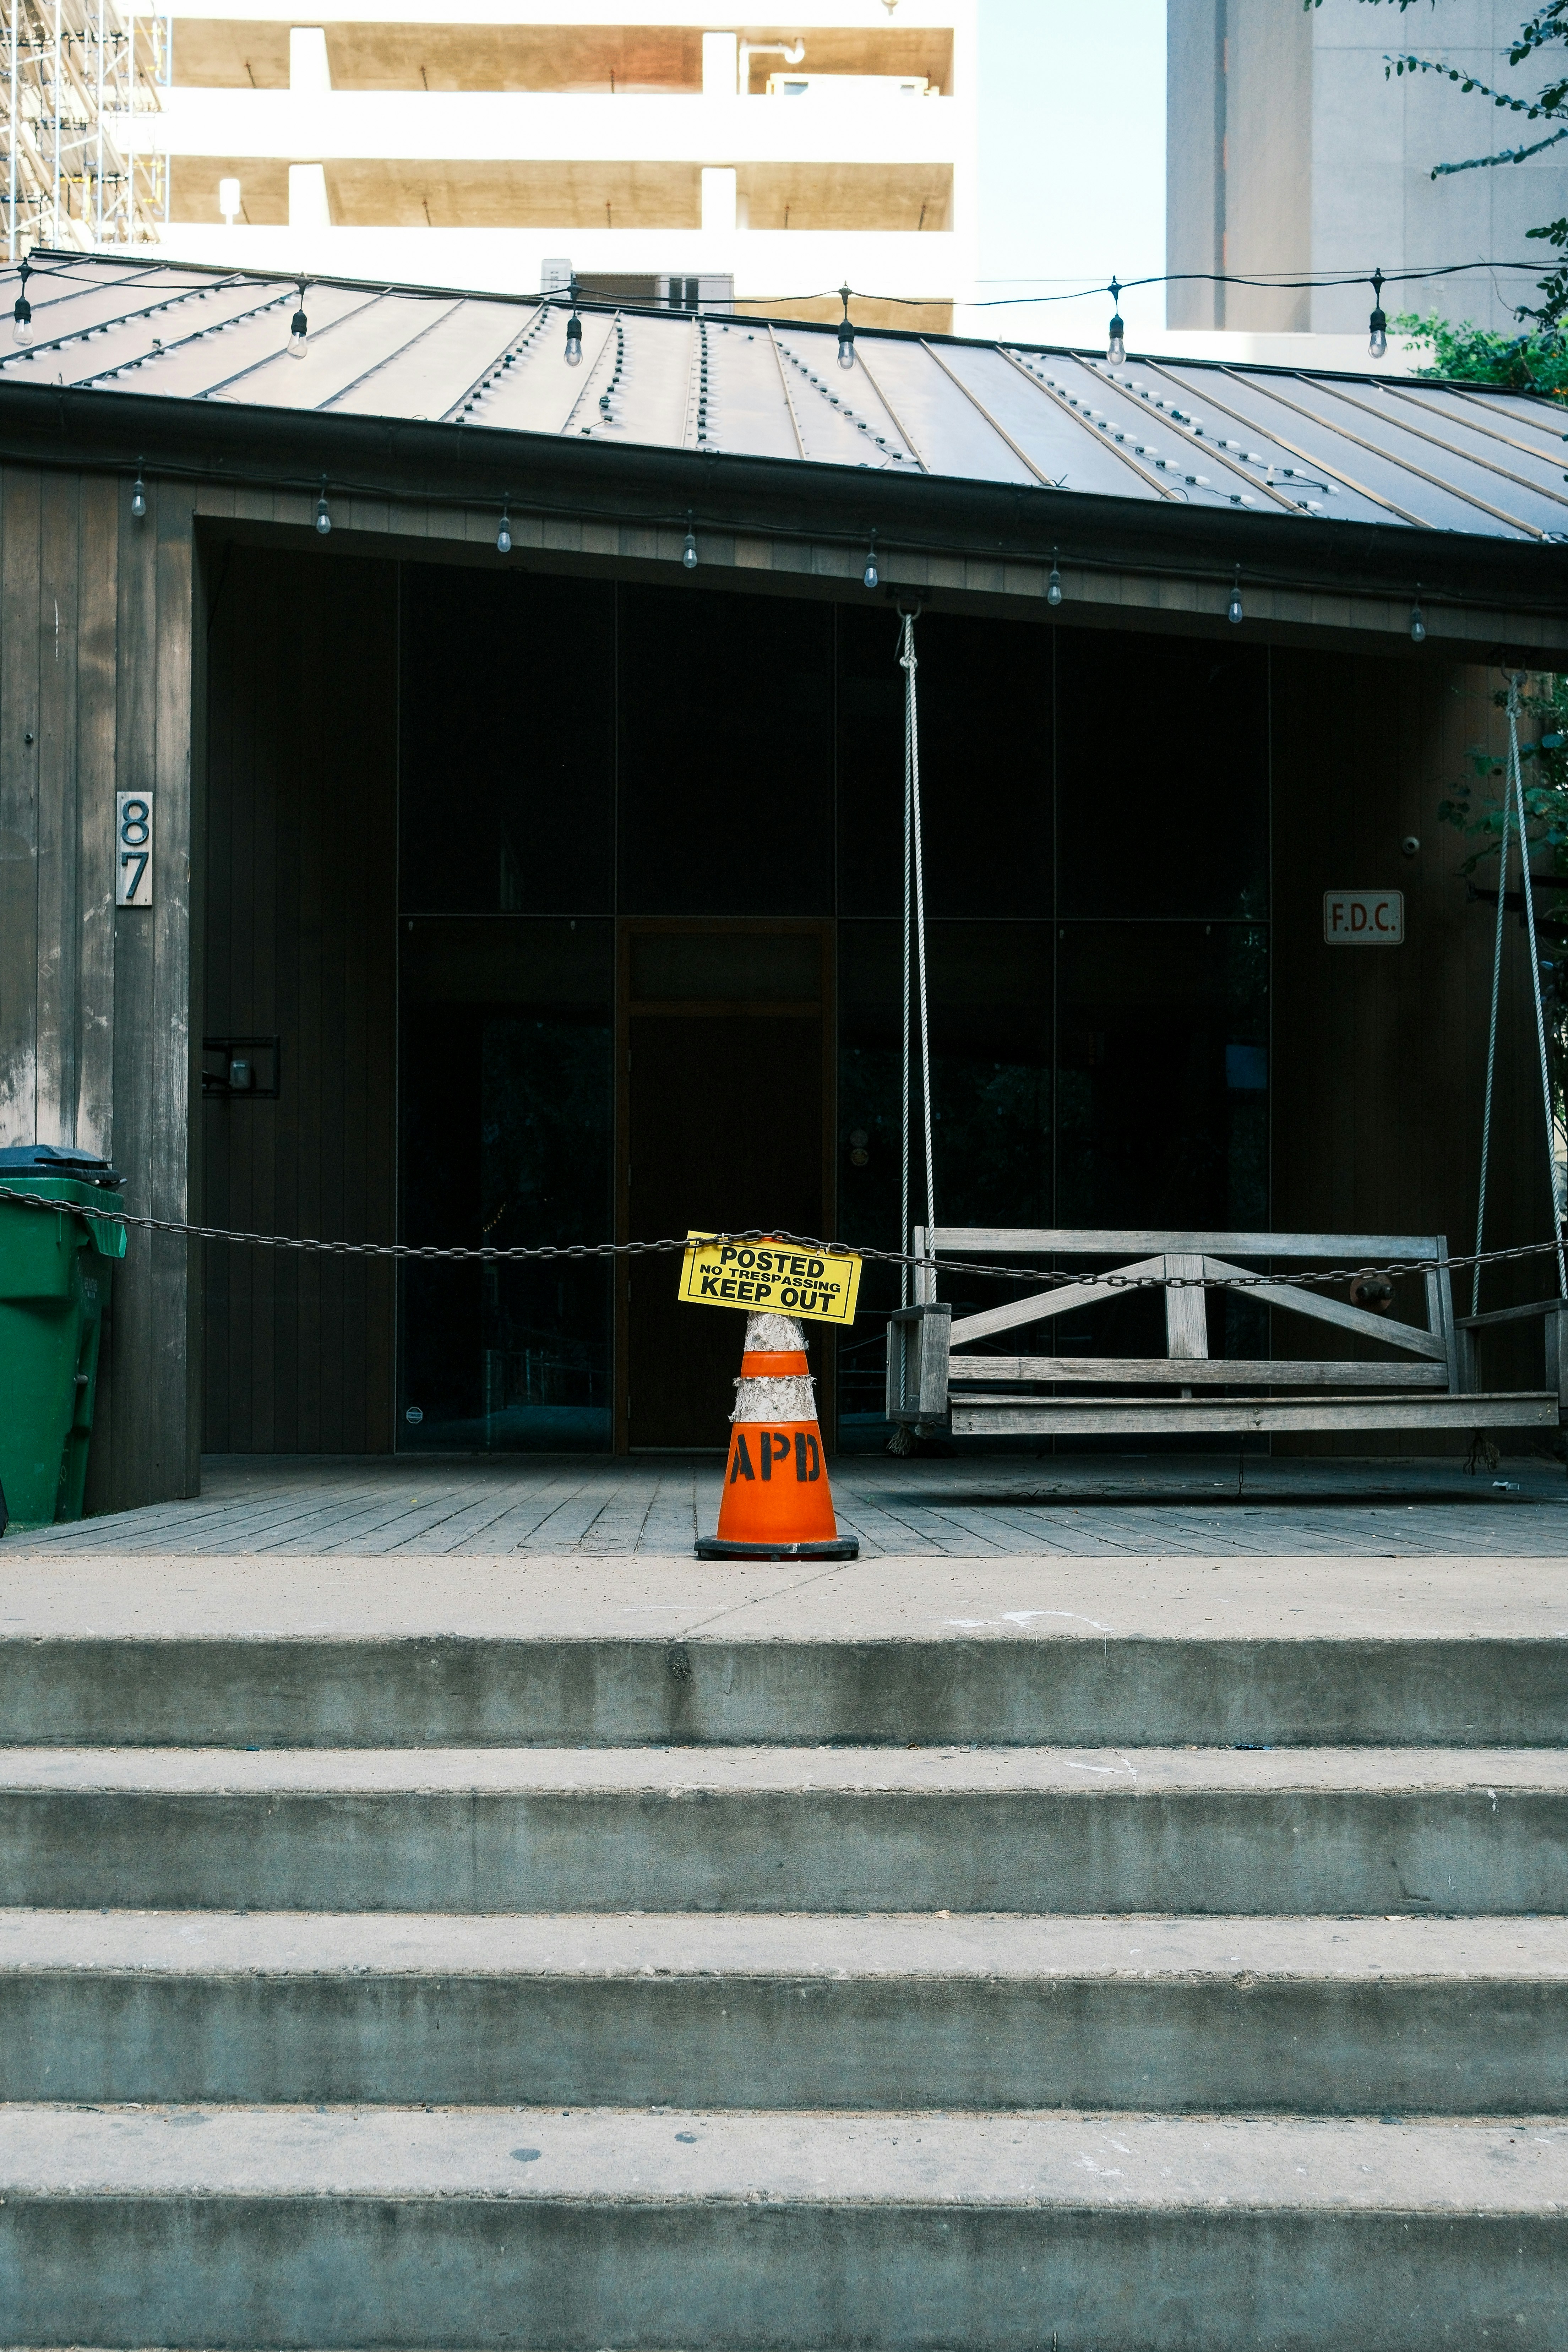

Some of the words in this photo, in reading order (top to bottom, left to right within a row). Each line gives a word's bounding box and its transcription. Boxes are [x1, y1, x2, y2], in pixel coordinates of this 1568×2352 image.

[121, 799, 149, 898] 87
[1332, 903, 1396, 931] F.D.C.
[700, 1264, 723, 1275] NO
[729, 1268, 840, 1292] TRESPASSING
[720, 1246, 824, 1278] POSTED
[701, 1276, 771, 1302] KEEP
[781, 1287, 835, 1312] OUT
[730, 1431, 820, 1483] APD
